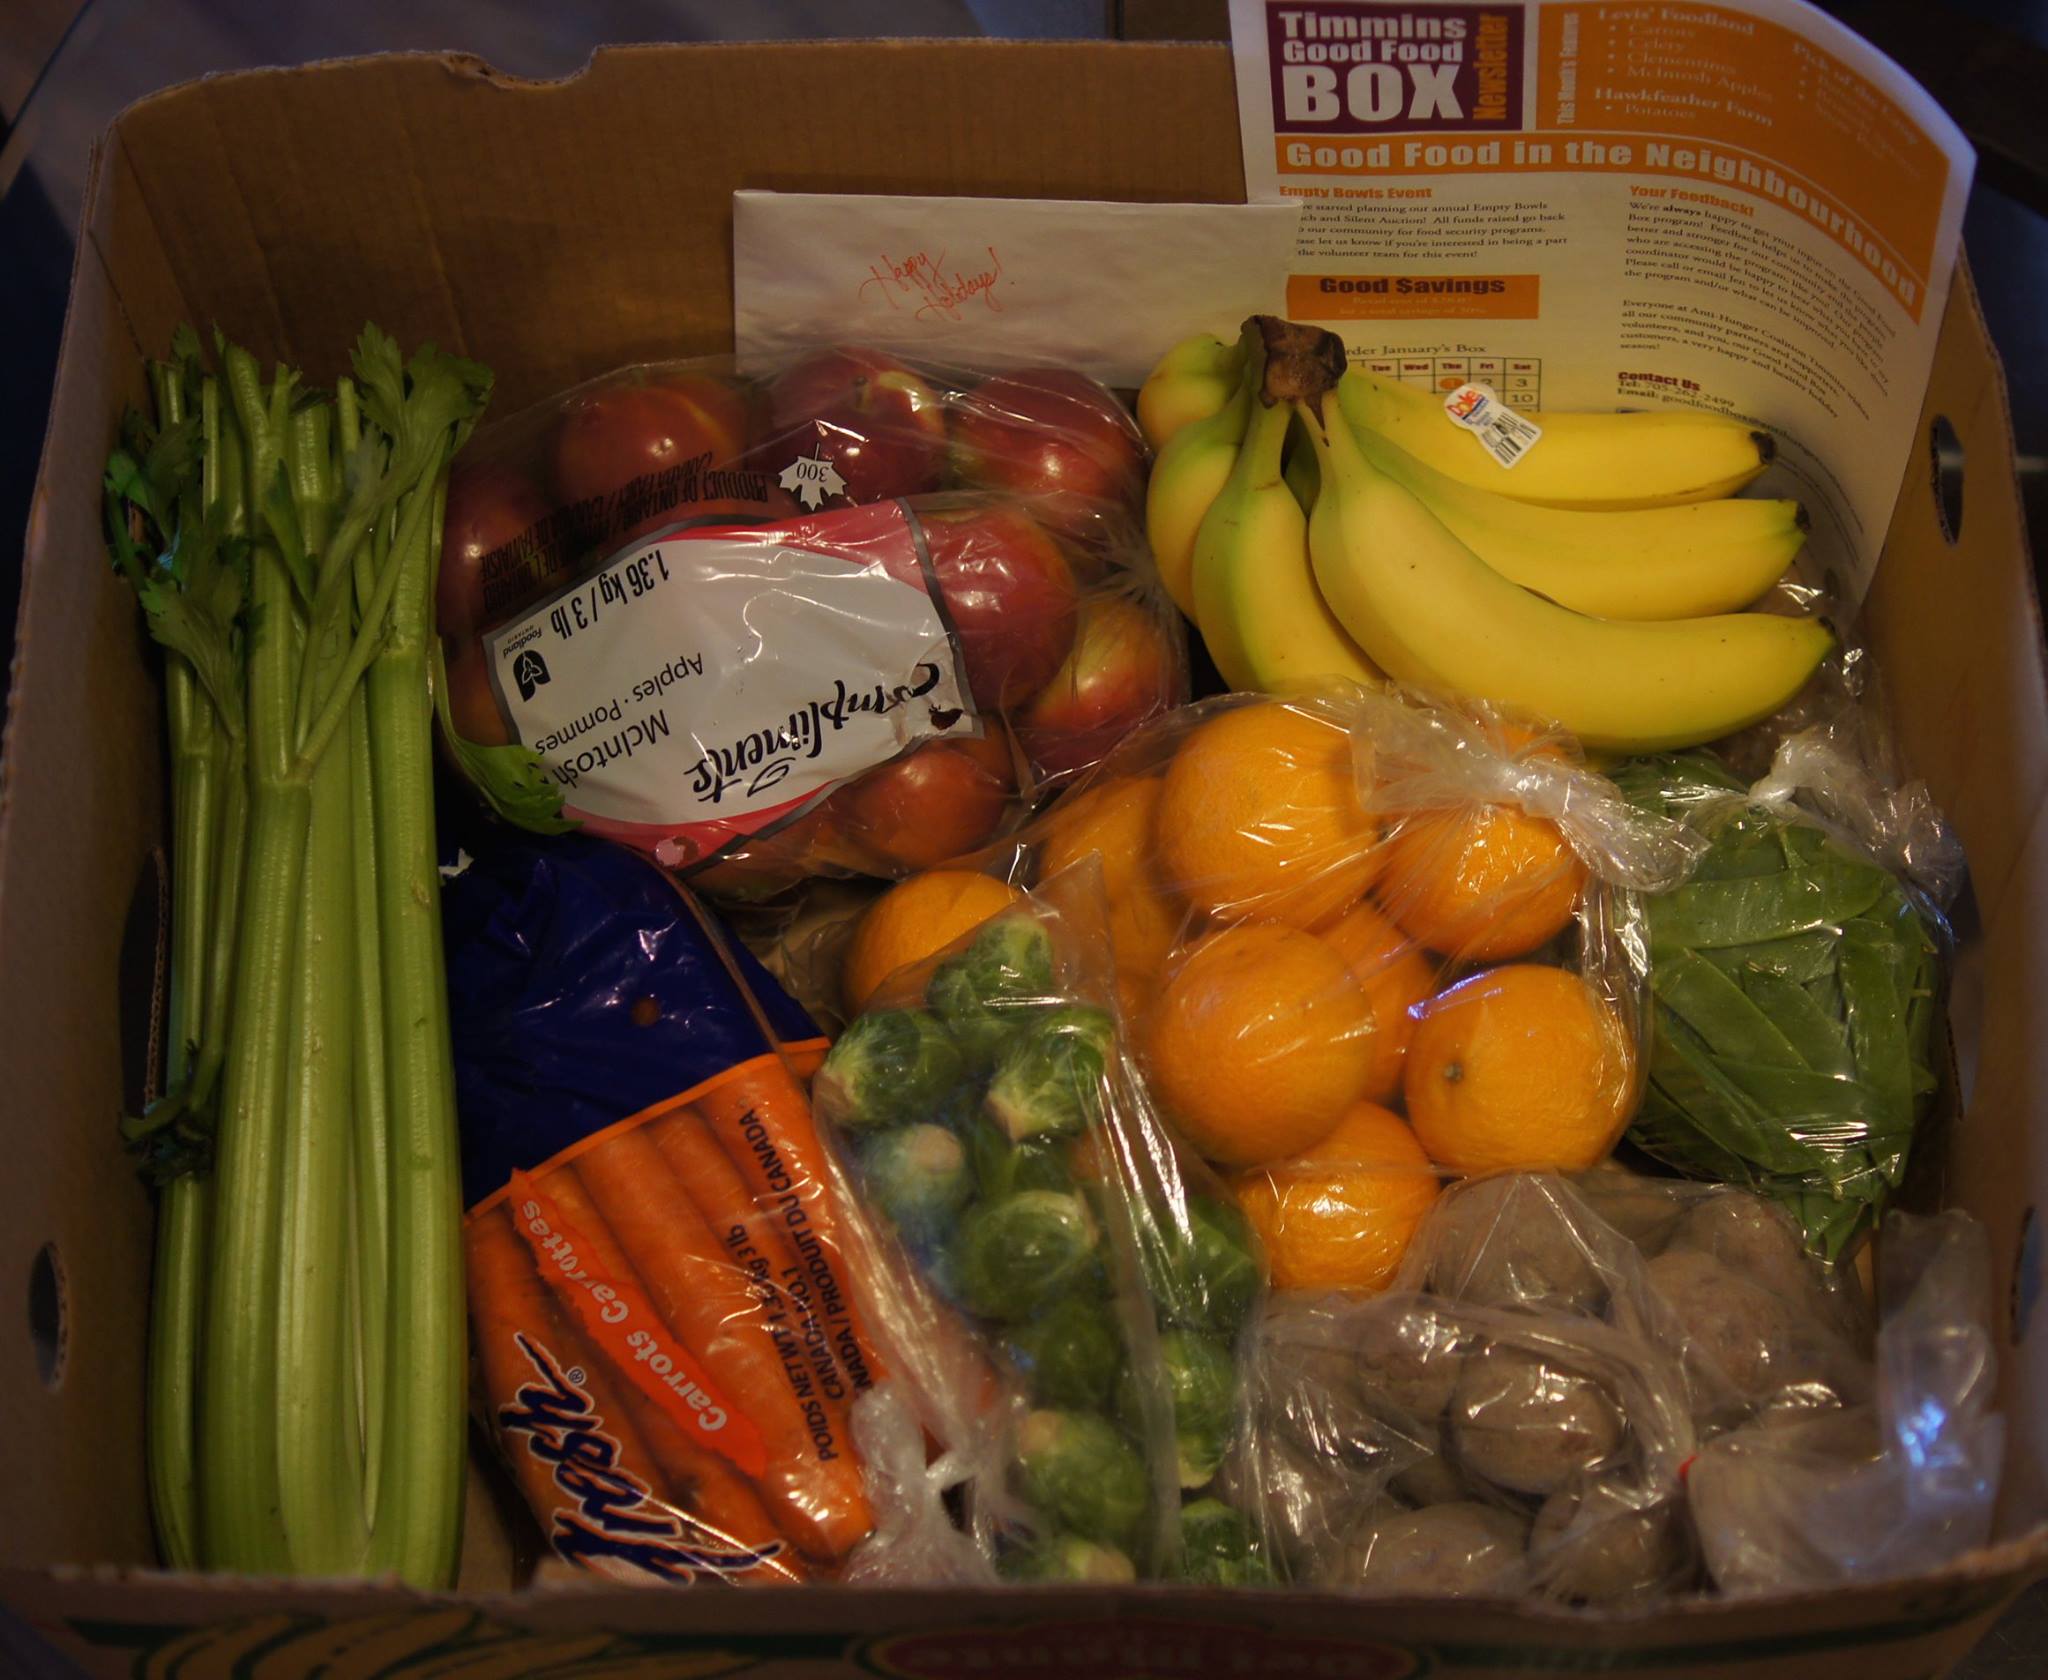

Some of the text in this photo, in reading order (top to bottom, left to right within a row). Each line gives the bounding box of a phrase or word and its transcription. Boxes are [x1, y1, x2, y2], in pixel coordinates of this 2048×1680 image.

[1279, 11, 1467, 38] Timmins
[1283, 41, 1463, 62] Good Food
[1473, 12, 1508, 120] Newsletter
[1282, 63, 1464, 121] BOX
[1279, 185, 1432, 199] Empty Bowls Event
[1630, 185, 1666, 198] Your
[1286, 140, 1917, 306] Good Food in the Neighbourhood
[1663, 205, 1701, 216] always
[858, 248, 946, 310] Happy
[1320, 277, 1389, 294] Good
[1343, 344, 1486, 355] rder January's Box
[1404, 363, 1429, 371] Wed
[1619, 371, 1700, 391] Contact Us
[1512, 394, 1534, 404] 10
[797, 463, 829, 482] 300
[599, 574, 627, 604] kg
[626, 550, 669, 597] 1.36
[551, 606, 572, 640] lb
[571, 597, 588, 629] 3
[502, 627, 542, 659] Foodland
[535, 653, 703, 755] Apples Pommes
[552, 709, 670, 788] McIntosh
[739, 1108, 791, 1192] CANADA
[778, 1194, 807, 1226] DU
[726, 1224, 747, 1247] lb
[737, 1246, 756, 1259] 3
[792, 1229, 846, 1315] PRODUIT
[801, 1314, 844, 1399] CANADA
[837, 1328, 872, 1390] NADA
[627, 1330, 727, 1431] Carrots
[785, 1363, 814, 1398] NET
[801, 1401, 838, 1461] POIDS
